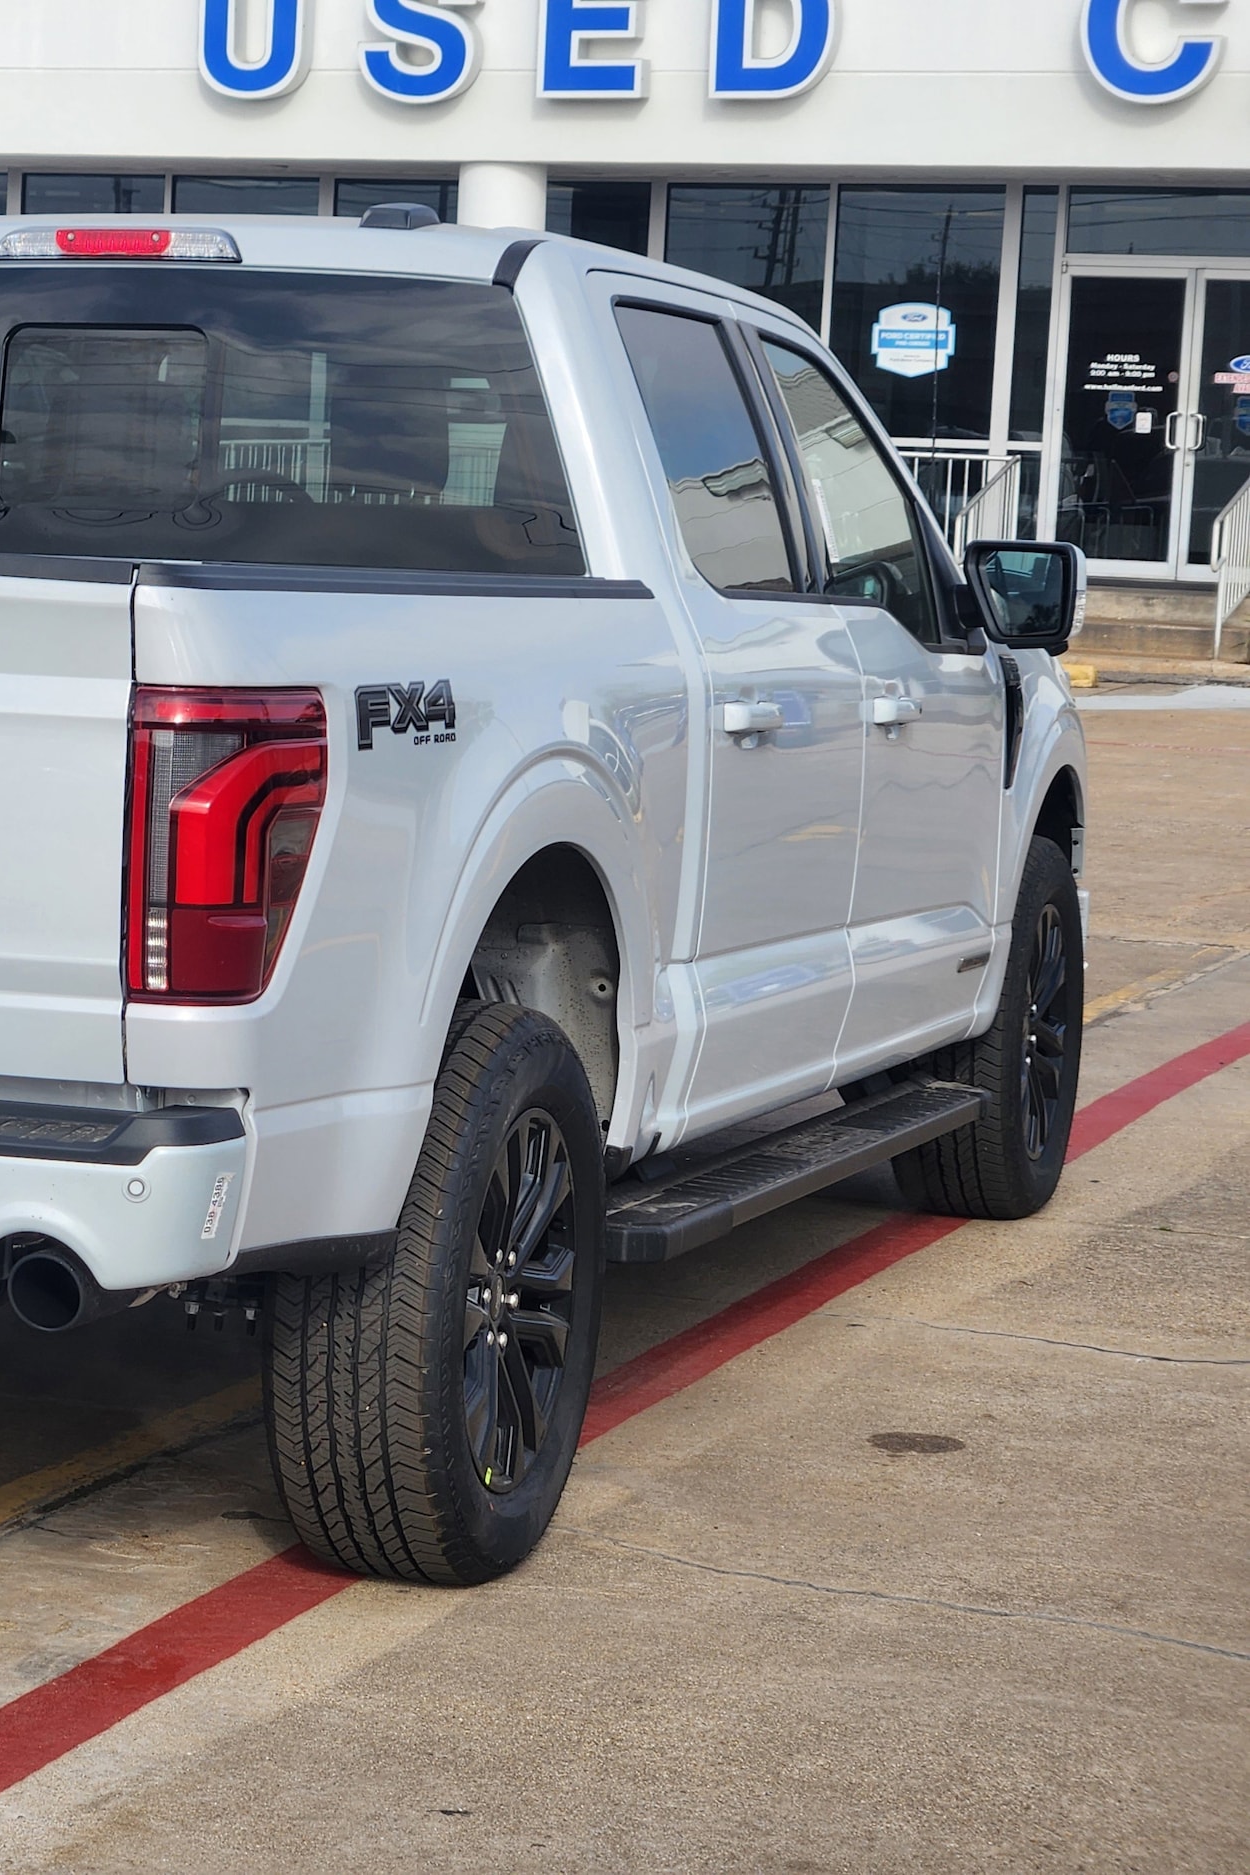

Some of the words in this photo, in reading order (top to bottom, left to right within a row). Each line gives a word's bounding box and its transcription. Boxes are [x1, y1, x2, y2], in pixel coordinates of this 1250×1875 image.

[198, 0, 838, 104] USED
[1106, 354, 1140, 362] HOURS
[1090, 362, 1118, 370] Monday
[1123, 363, 1156, 371] Saturday
[354, 679, 456, 751] FX4
[413, 734, 431, 746] OFF
[434, 732, 456, 743] ROAD
